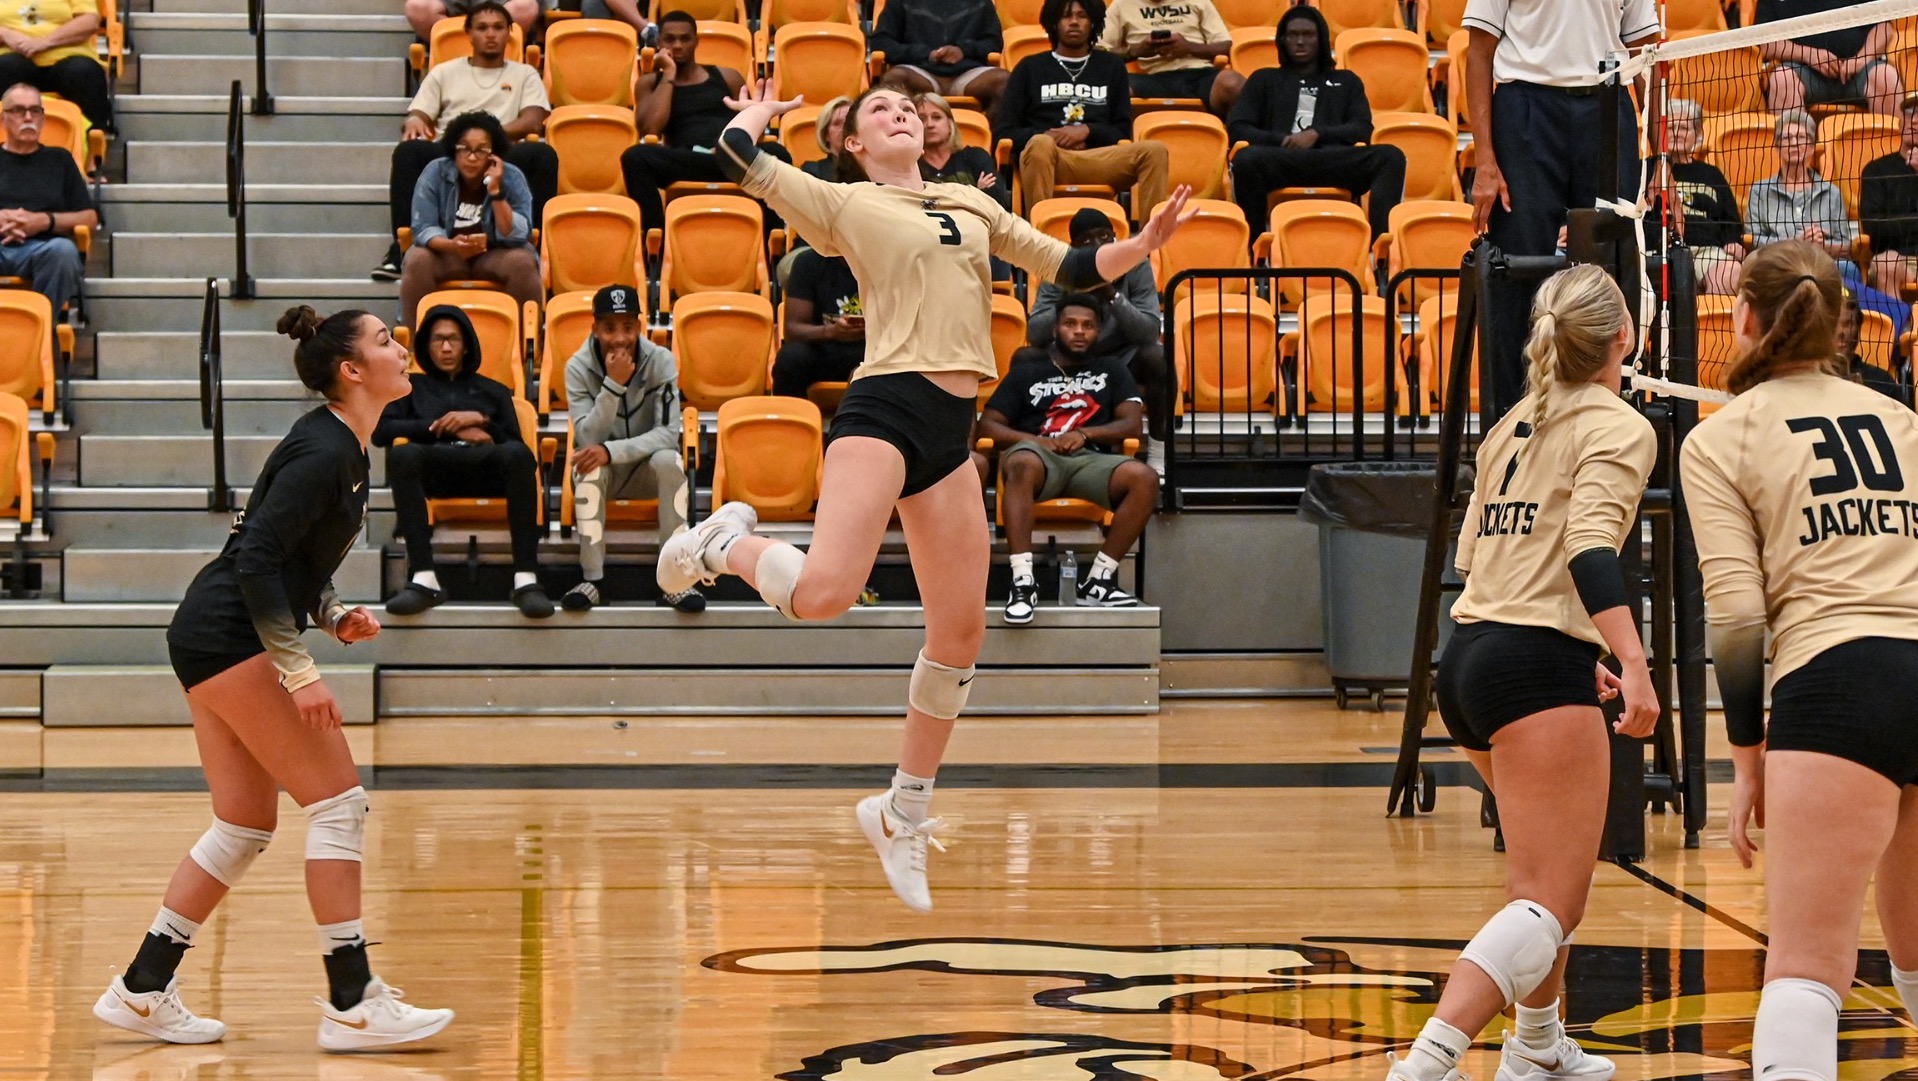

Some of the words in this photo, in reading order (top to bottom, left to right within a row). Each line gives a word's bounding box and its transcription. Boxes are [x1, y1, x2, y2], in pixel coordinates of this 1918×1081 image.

[1140, 5, 1191, 19] WVSU
[1041, 83, 1107, 100] HBCU
[924, 212, 962, 246] 3
[1029, 372, 1108, 407] STONES
[1785, 414, 1904, 497] 30
